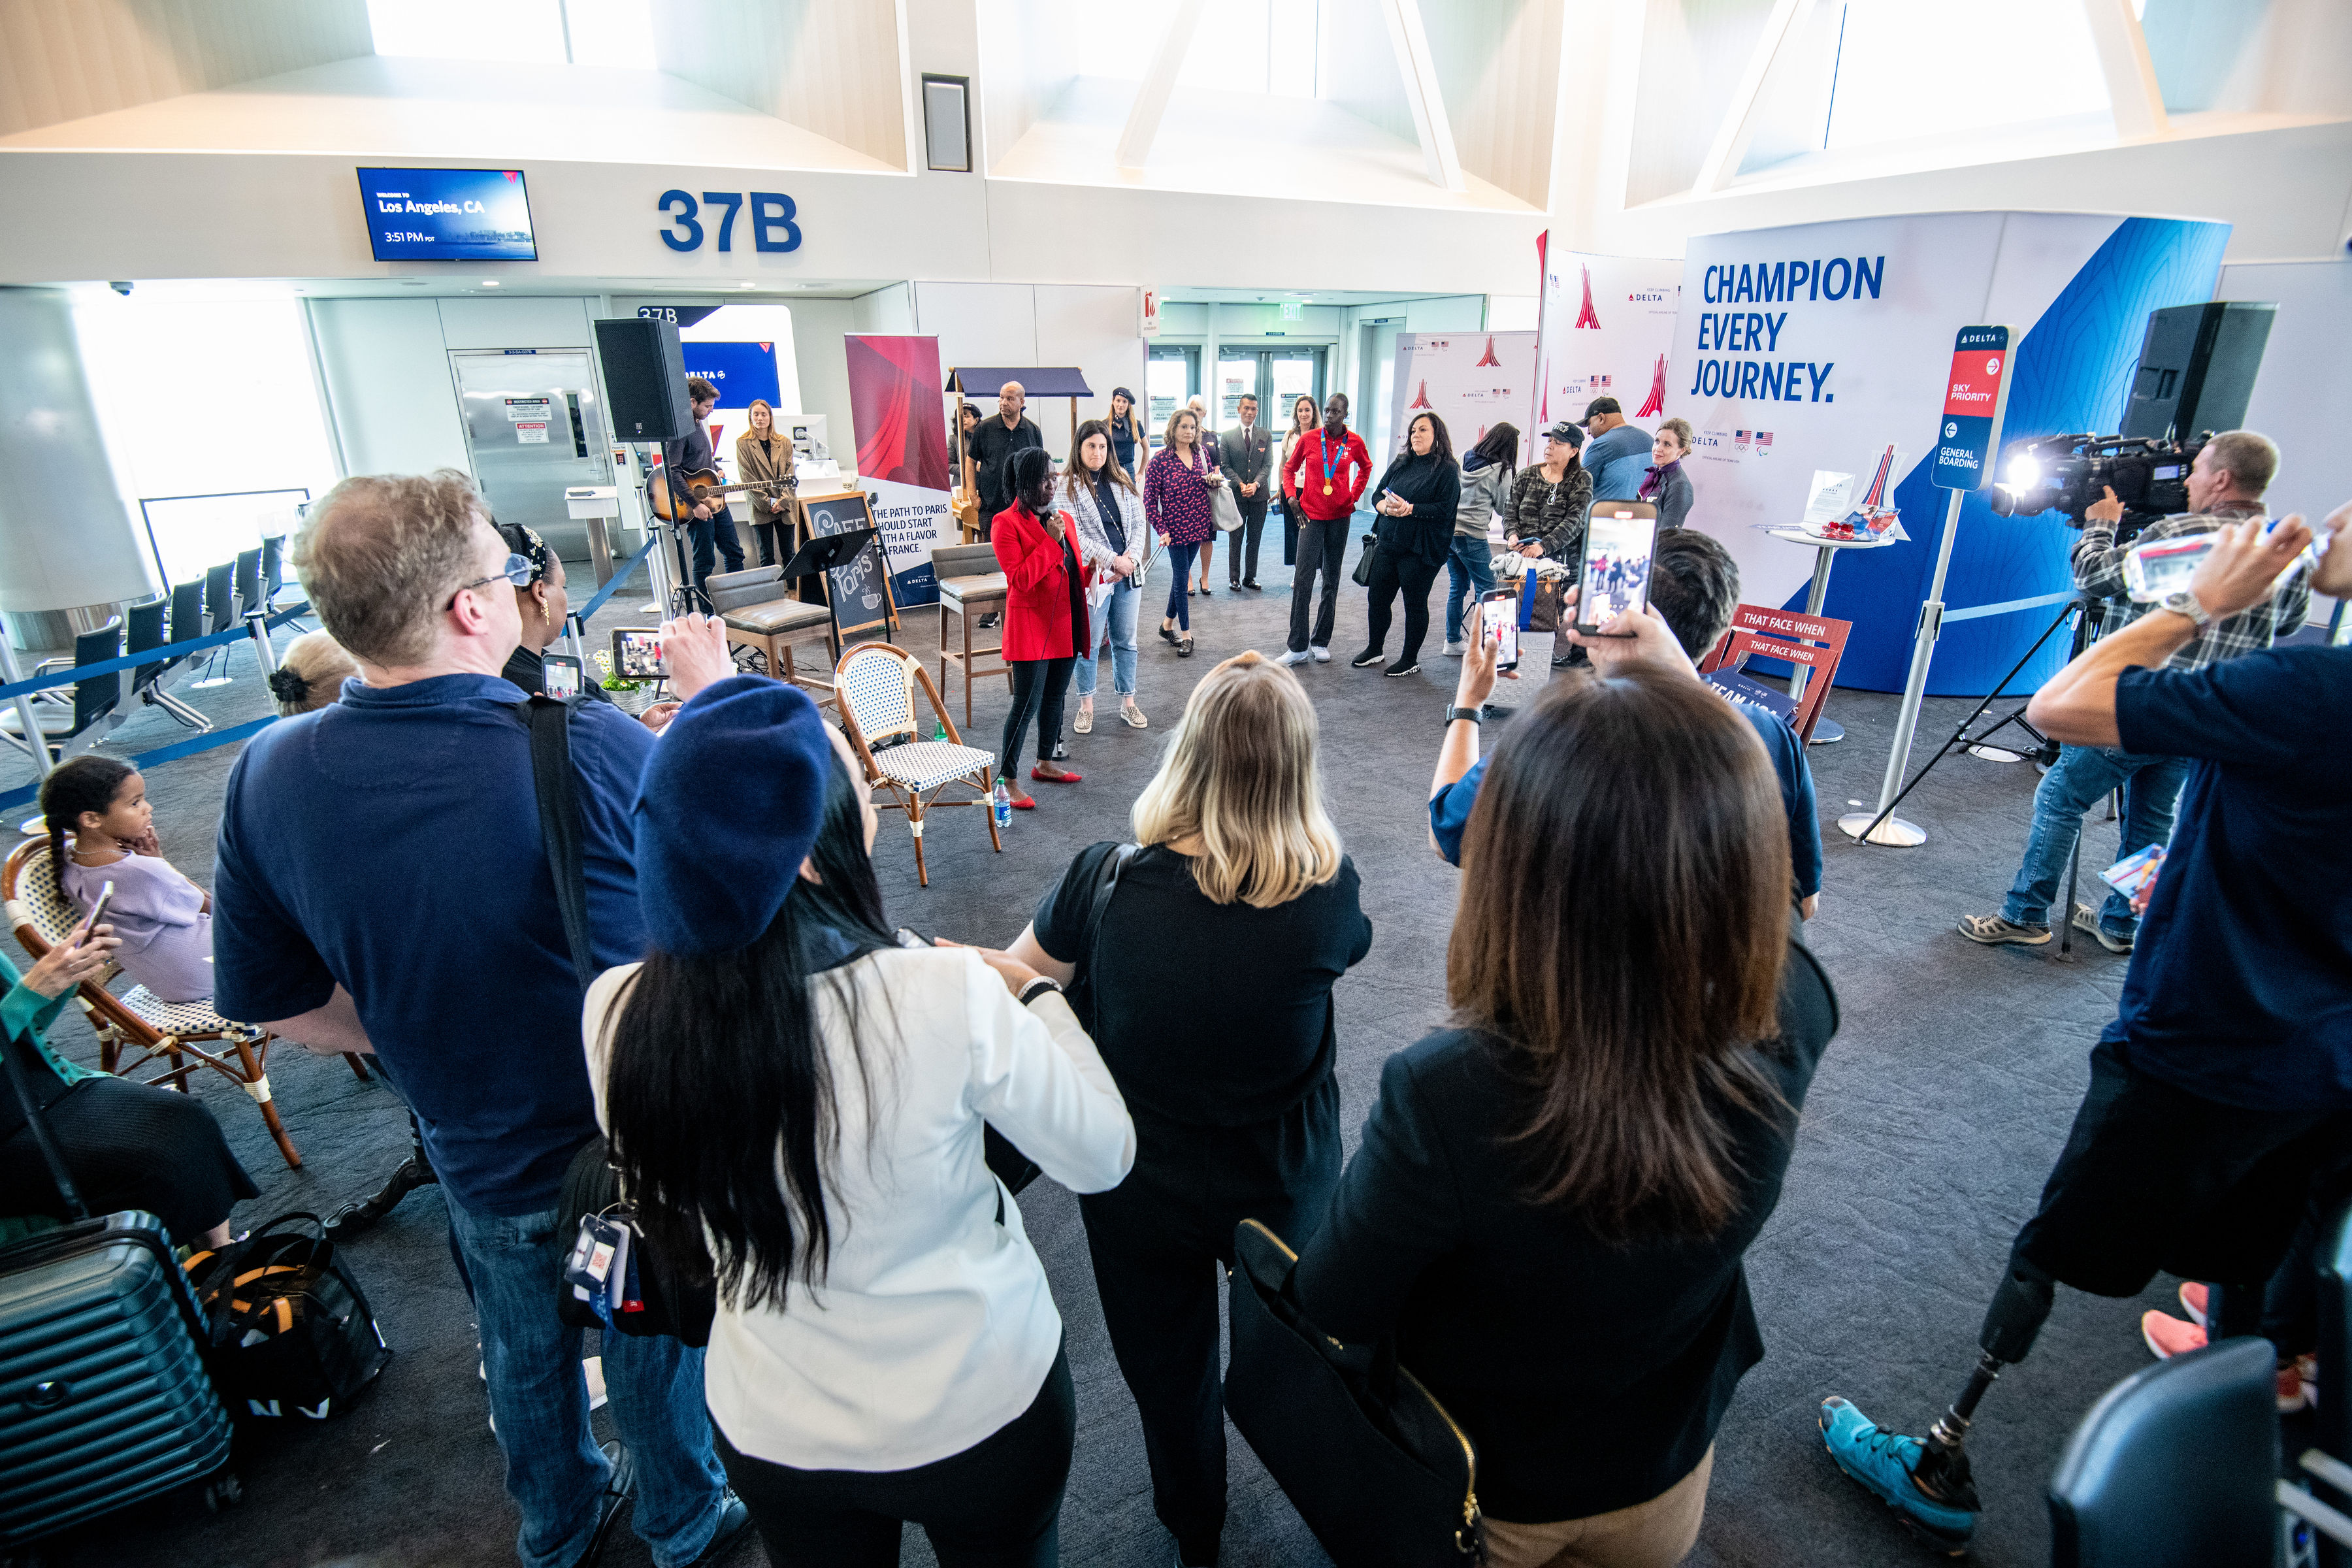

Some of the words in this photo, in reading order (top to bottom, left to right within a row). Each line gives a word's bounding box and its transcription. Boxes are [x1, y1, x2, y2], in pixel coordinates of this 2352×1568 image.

[378, 201, 402, 213] Los
[406, 201, 462, 215] Angeles,
[464, 201, 485, 214] CA
[659, 189, 802, 252] 37B
[385, 233, 404, 242] 3:51
[407, 233, 424, 242] PM
[1704, 255, 1885, 304] CHAMPION
[640, 308, 678, 324] 37B
[1284, 303, 1301, 319] EXIT
[1698, 312, 1788, 351] EVERY
[1969, 334, 1996, 343] DELTA
[1691, 359, 1835, 403] JOURNEY.
[1951, 393, 1991, 402] PRIORITY
[1692, 436, 1718, 447] DELTA
[1940, 447, 1974, 459] GENERAL
[1938, 456, 1978, 469] BOARDING
[890, 507, 910, 517] PATH
[912, 506, 923, 515] TO
[926, 504, 947, 514] PARIS
[879, 521, 906, 531] HOULD
[908, 518, 932, 528] START
[883, 534, 897, 543] ITH
[899, 533, 905, 542] A
[906, 530, 937, 540] FLAVOR
[889, 544, 922, 555] FRANCE.
[1744, 612, 1769, 626] THAT
[1769, 617, 1793, 631] FACE
[1794, 621, 1826, 636] WHEN
[1528, 639, 1551, 647] Klein
[1750, 640, 1771, 652] THAT
[1770, 644, 1789, 657] FACE
[1789, 648, 1815, 662] WHEN
